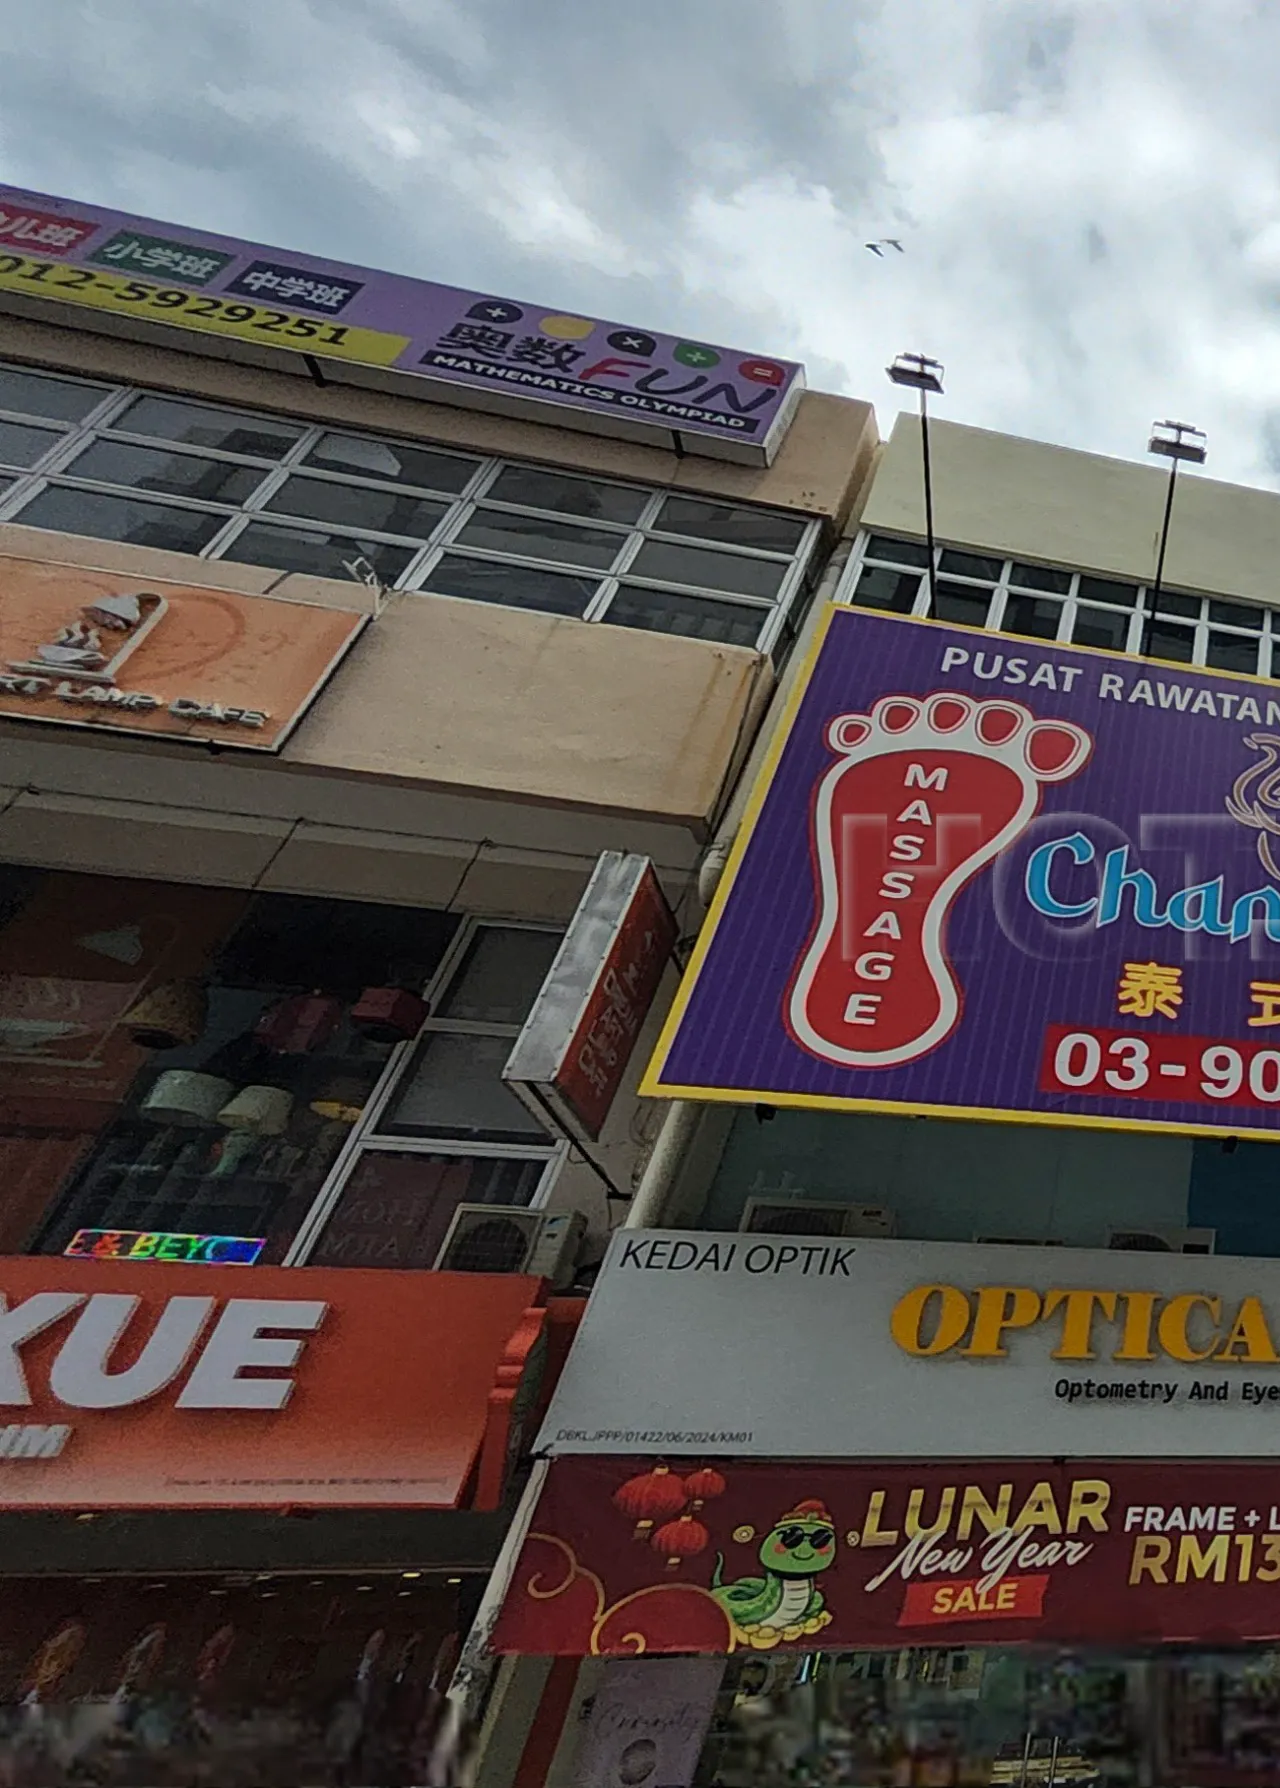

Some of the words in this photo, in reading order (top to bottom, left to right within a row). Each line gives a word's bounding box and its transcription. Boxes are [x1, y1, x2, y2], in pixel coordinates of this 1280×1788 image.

[102, 241, 220, 280] 小学班
[243, 270, 351, 308] 中学班
[437, 322, 588, 374] 奥数
[432, 354, 617, 402] MATHEMATICS
[619, 395, 747, 429] OLYMPIAD
[578, 356, 778, 413] FUN
[940, 646, 1084, 694] PUSAT
[843, 763, 949, 1026] MASSAGE
[619, 1239, 738, 1274] KEDAI
[743, 1243, 856, 1278] OPTIK
[1054, 1377, 1179, 1405] Optometry
[1188, 1380, 1230, 1402] And
[860, 1478, 1112, 1548] LUNAR
[1123, 1505, 1237, 1533] FRAME
[1243, 1510, 1261, 1528] +
[864, 1527, 974, 1593] New
[975, 1525, 1095, 1595] Year
[931, 1582, 1020, 1614] SALE
